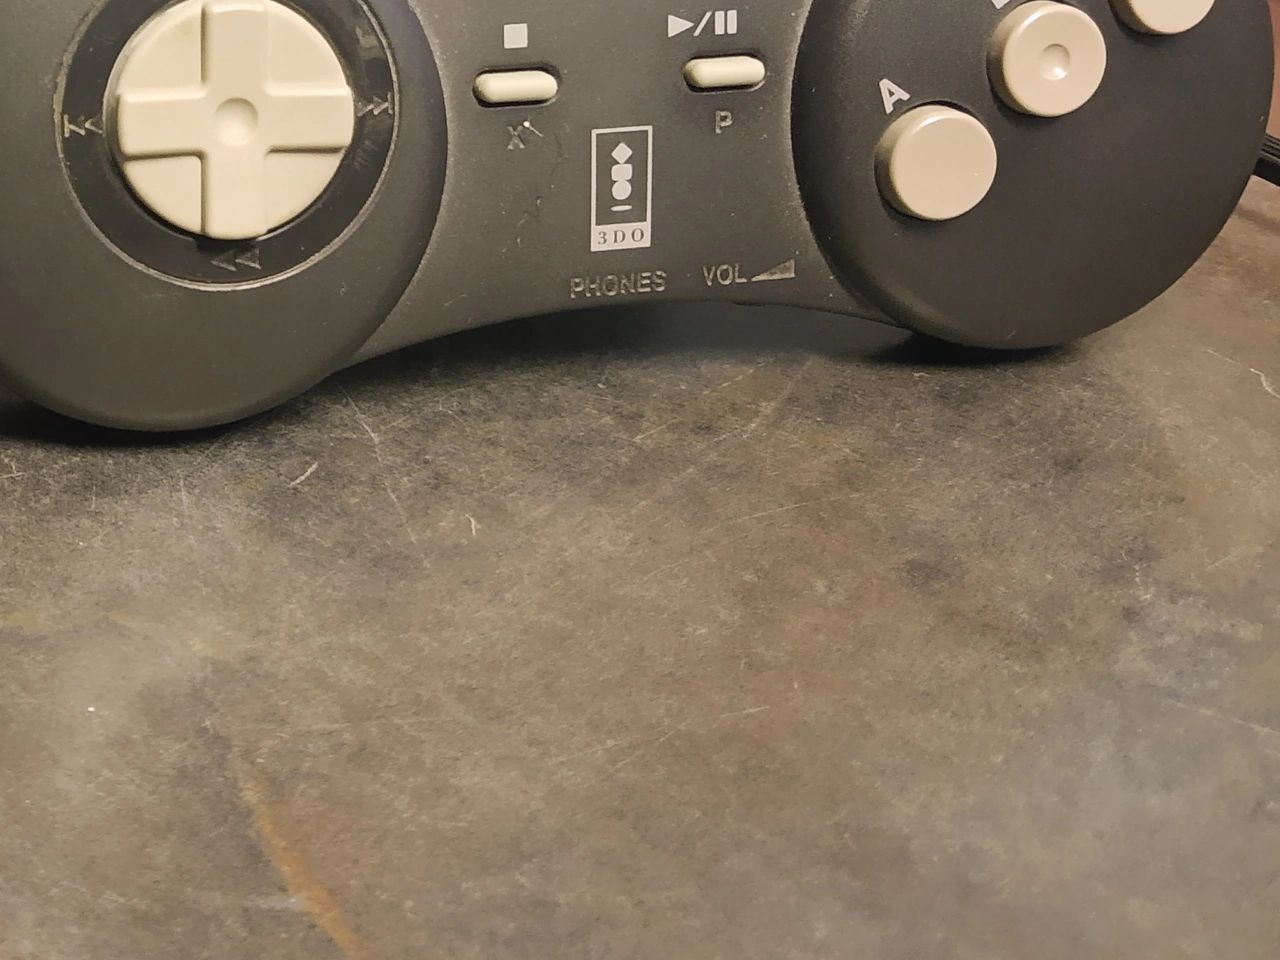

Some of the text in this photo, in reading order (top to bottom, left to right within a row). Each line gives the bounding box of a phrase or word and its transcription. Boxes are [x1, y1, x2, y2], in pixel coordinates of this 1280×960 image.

[879, 78, 911, 114] A
[715, 111, 733, 134] P
[506, 125, 526, 150] X
[597, 228, 645, 245] 3DO
[570, 270, 667, 299] PHONES
[702, 263, 747, 287] VOL
